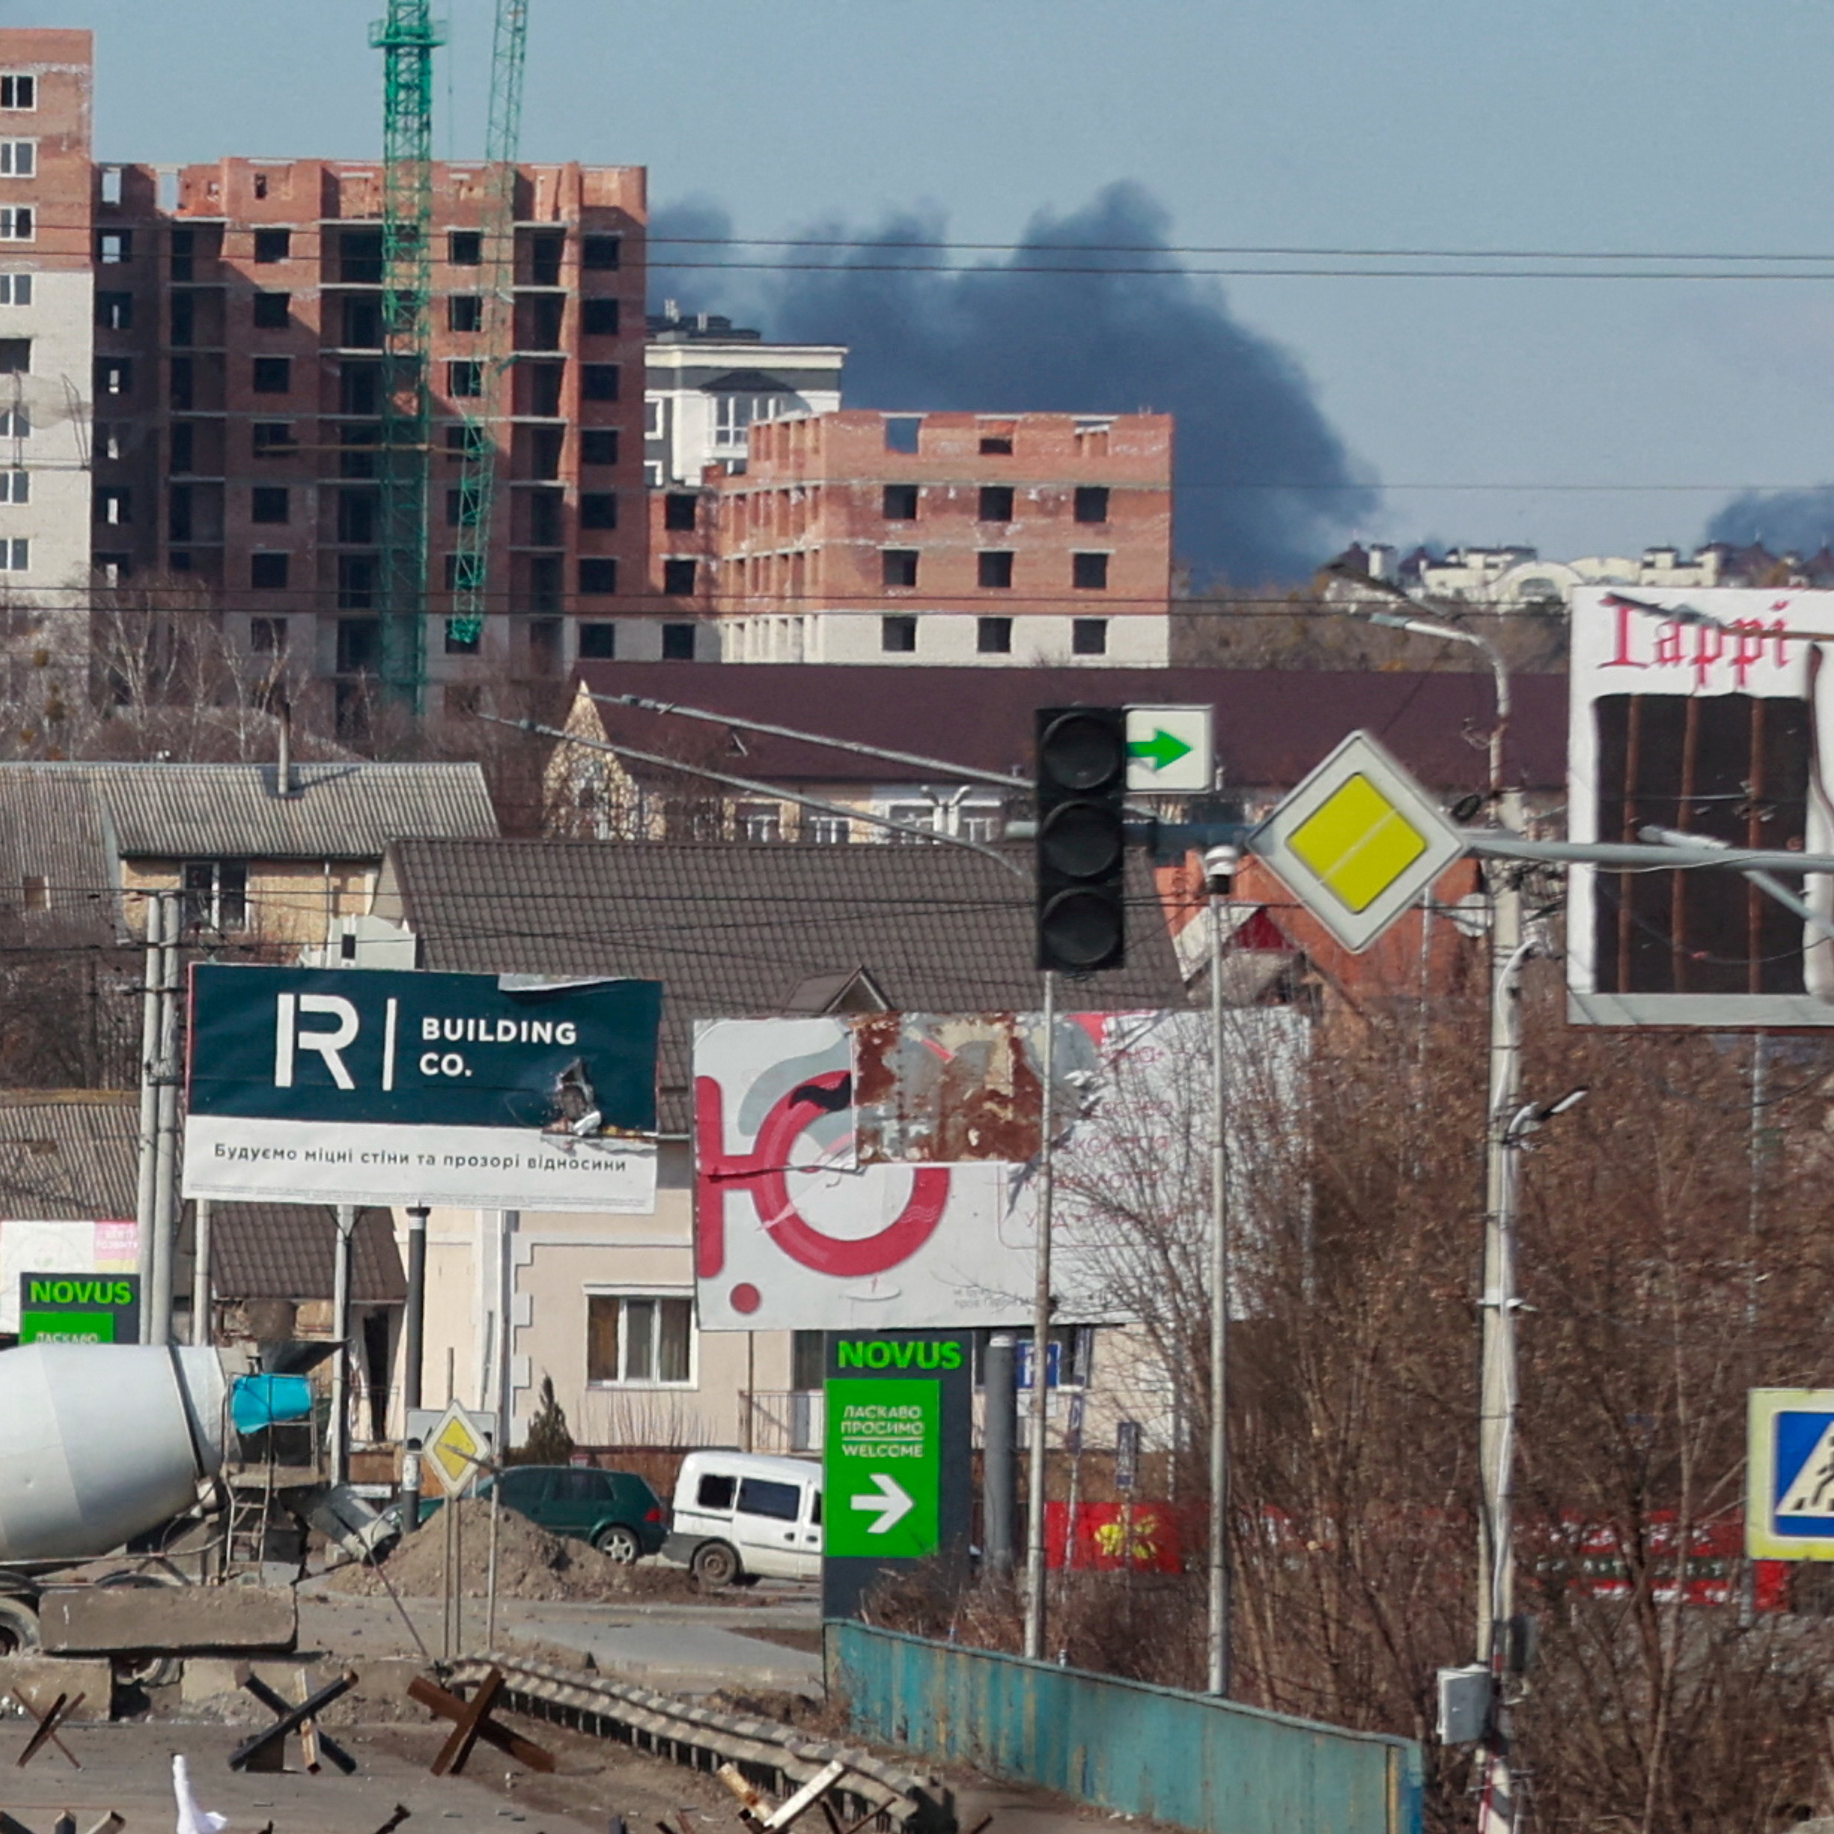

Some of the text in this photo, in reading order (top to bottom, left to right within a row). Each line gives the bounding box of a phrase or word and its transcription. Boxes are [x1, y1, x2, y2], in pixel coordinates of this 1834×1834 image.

[422, 1017, 577, 1046] BUILDING
[419, 1052, 472, 1077] CO.
[215, 1143, 626, 1172] Будуємо міцні стіни та прозорі відносини
[30, 1281, 132, 1305] NOVUS
[838, 1341, 961, 1370] NOVUS
[843, 1405, 922, 1419] ЛАСКАВО
[841, 1421, 924, 1434] ПРОСИМО
[842, 1444, 924, 1458] WELCOME
